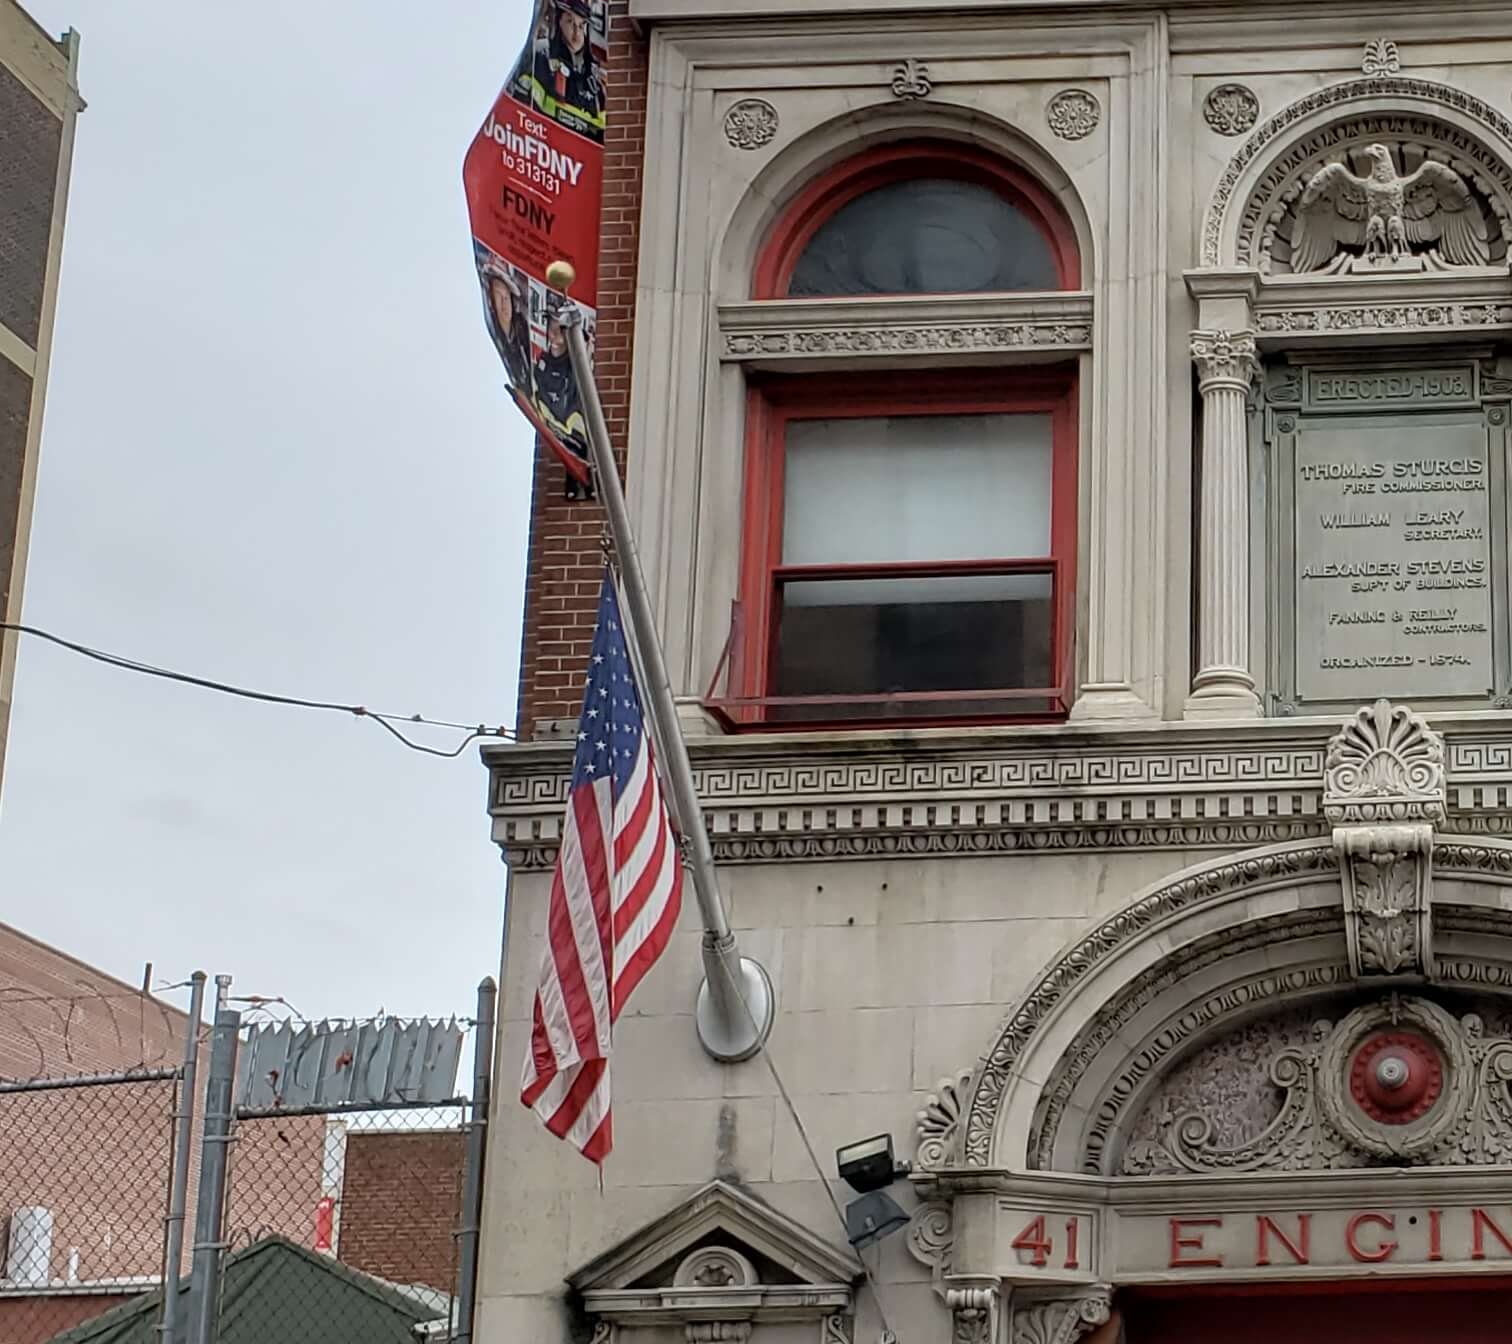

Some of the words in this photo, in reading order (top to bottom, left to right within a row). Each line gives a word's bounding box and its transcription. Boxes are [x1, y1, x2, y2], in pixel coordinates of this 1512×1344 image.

[517, 110, 548, 139] Text:
[483, 113, 584, 186] JoinFDNY
[502, 150, 514, 170] to
[516, 158, 560, 195] 313131
[503, 184, 555, 235] FDNY
[1301, 462, 1385, 481] THOMAS
[1393, 457, 1483, 478] STURGIS
[1343, 482, 1376, 495] FIRE
[1381, 479, 1485, 494] COMMISSIONER.
[1320, 512, 1391, 529] WILLIAM
[1405, 510, 1464, 526] LEARY
[1302, 562, 1400, 579] ALEXANDER
[1407, 559, 1485, 575] STEVENS
[1393, 579, 1411, 592] OF
[1329, 610, 1386, 625] FANNING
[1391, 611, 1403, 623] &
[1409, 609, 1459, 623] REILLY
[1320, 654, 1414, 669] ORGANIZED
[1010, 1215, 1079, 1269] 41
